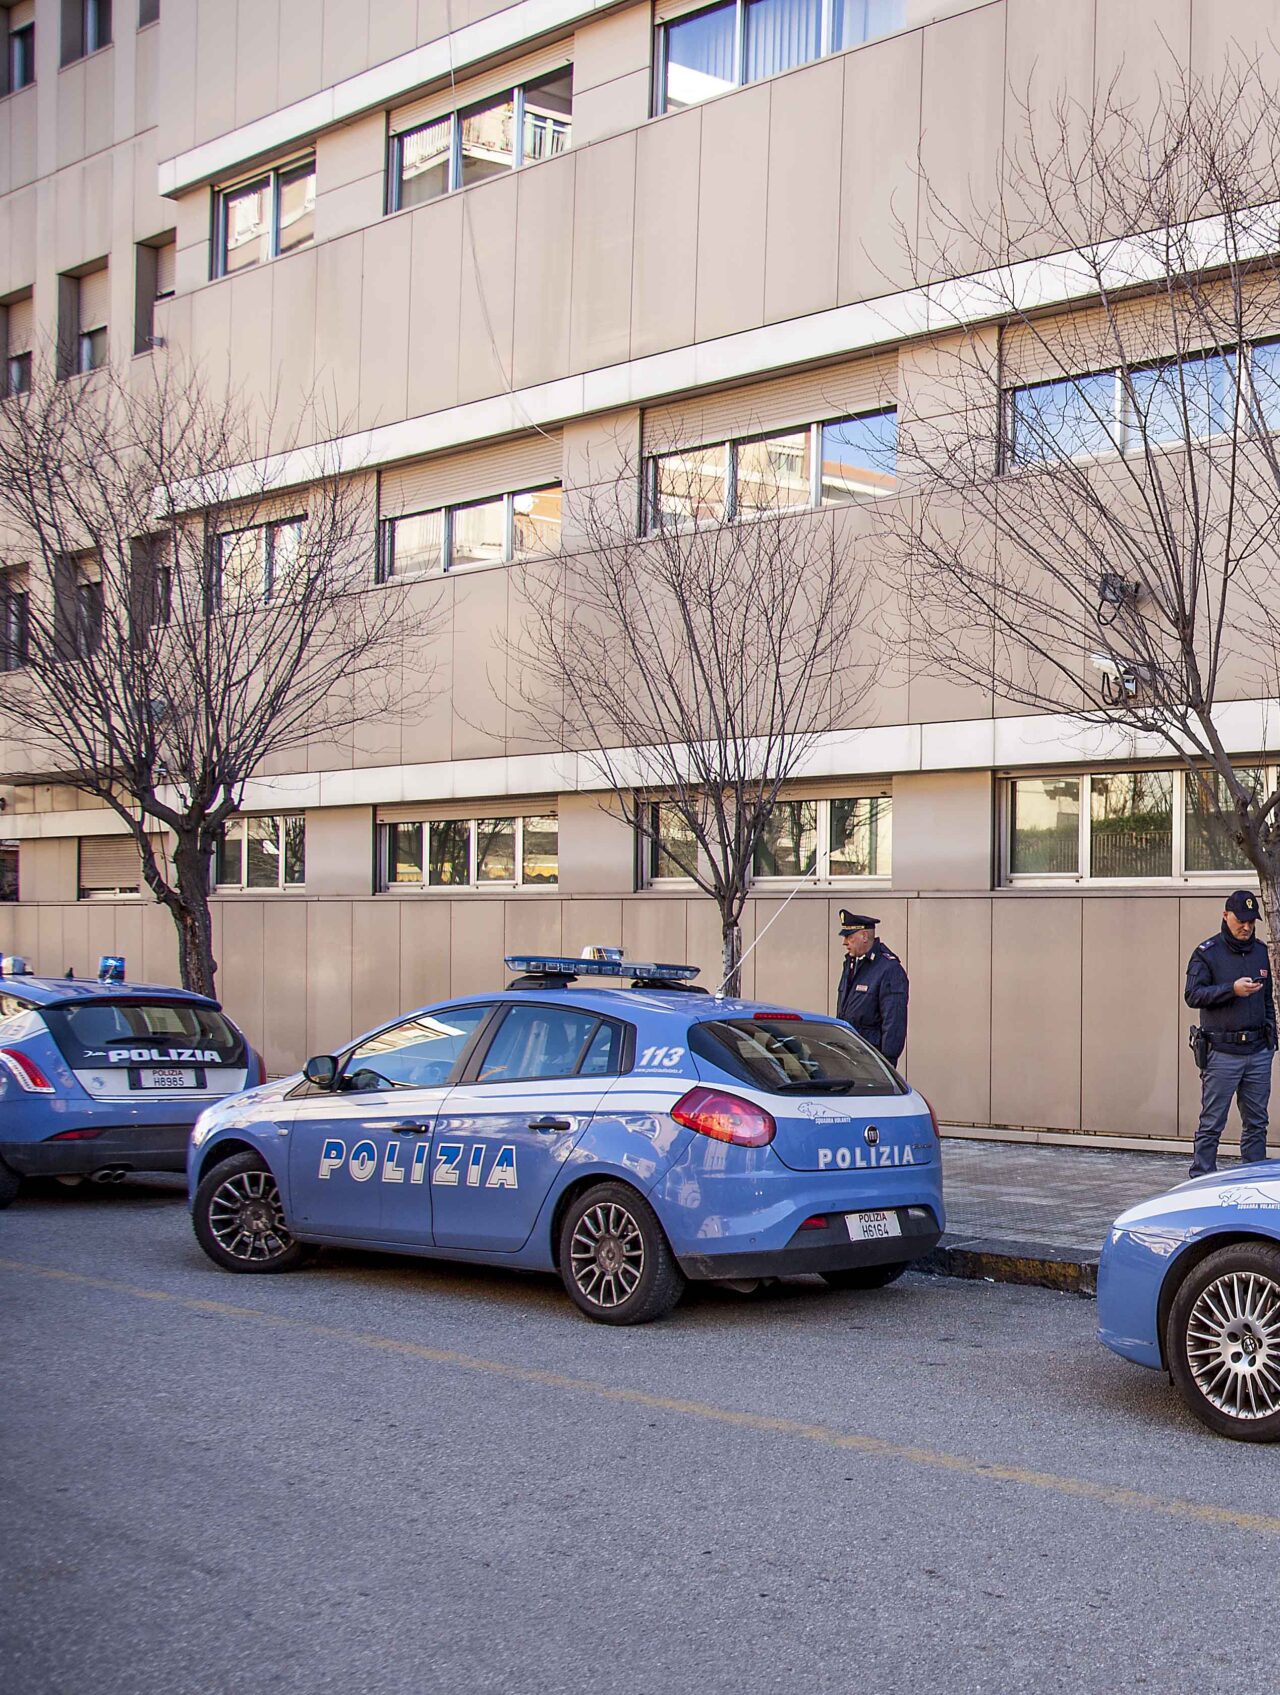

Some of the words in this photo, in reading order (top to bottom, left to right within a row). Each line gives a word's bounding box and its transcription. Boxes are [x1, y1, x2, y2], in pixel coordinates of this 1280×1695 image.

[108, 1048, 222, 1063] POLIZIA
[639, 1046, 686, 1067] 113
[152, 1069, 184, 1077] POLIZIA
[154, 1077, 185, 1087] H8985
[317, 1138, 519, 1189] POLIZIA
[817, 1144, 916, 1170] POLIZIA
[859, 1212, 888, 1223] POLIZIA
[861, 1223, 890, 1239] H6164
